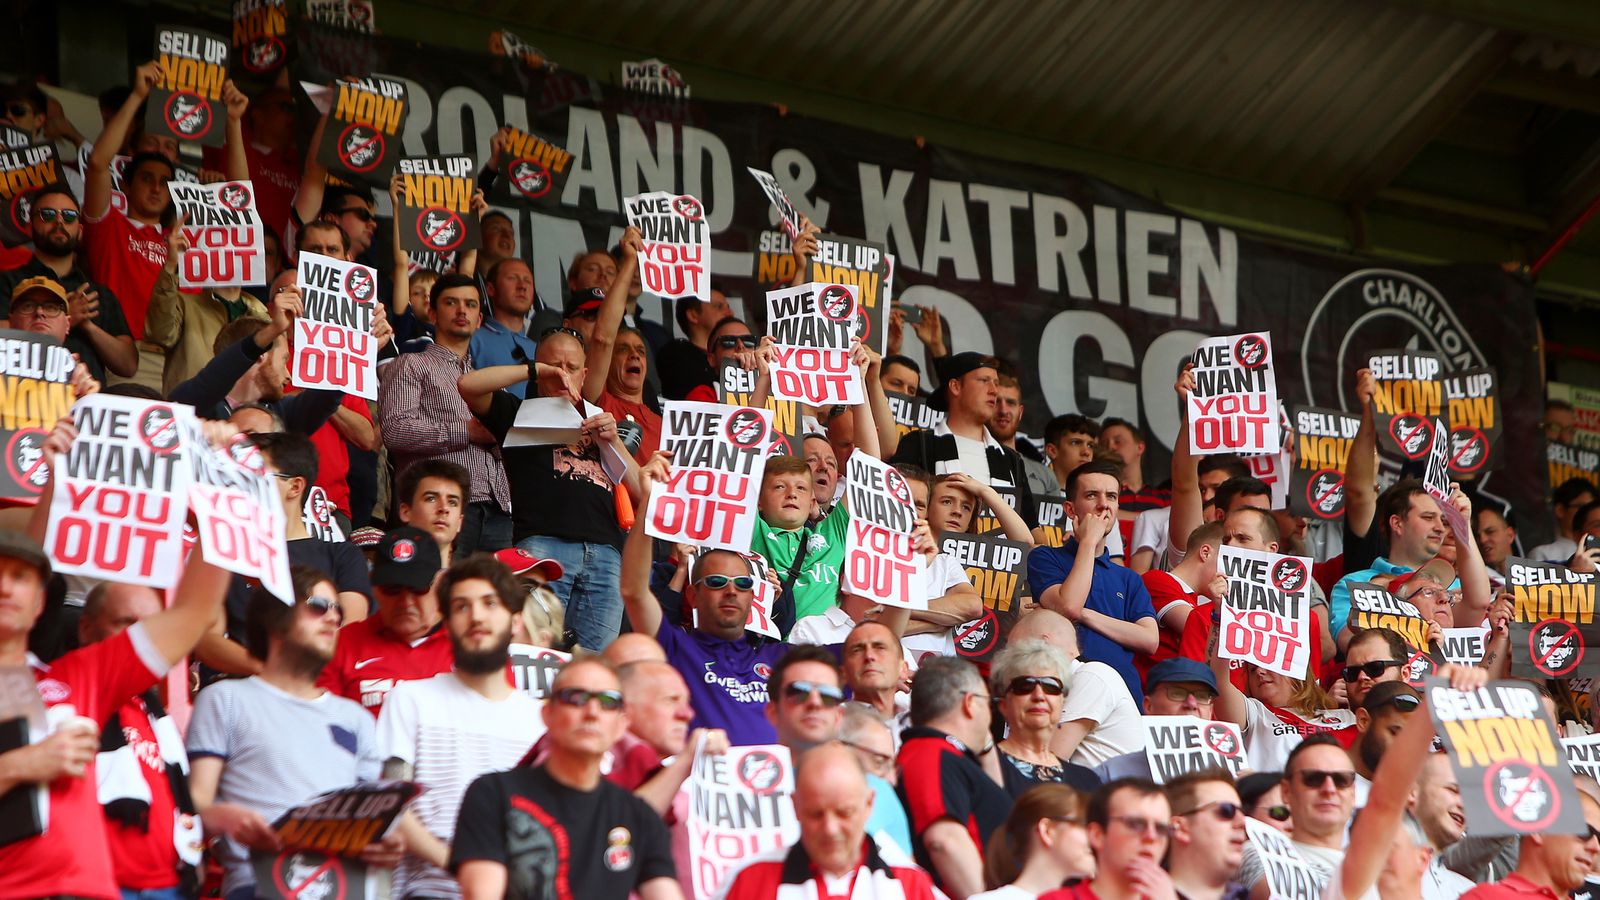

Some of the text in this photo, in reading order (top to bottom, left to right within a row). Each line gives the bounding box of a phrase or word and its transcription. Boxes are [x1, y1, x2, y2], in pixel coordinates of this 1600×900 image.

[159, 31, 227, 65] SELL UP
[157, 54, 226, 101] NOW
[627, 64, 661, 79] WE
[381, 80, 404, 100] UP
[335, 84, 404, 135] NOW
[0, 145, 53, 172] ELL UP
[506, 126, 571, 173] NOW
[399, 157, 473, 177] SELL UP
[175, 186, 217, 206] WE
[404, 175, 473, 214] NOW
[630, 198, 672, 216] WE
[178, 203, 254, 226] WANT
[634, 216, 704, 243] WANT
[183, 227, 255, 248] YOU
[641, 243, 702, 263] YOU
[759, 231, 791, 253] SEL
[858, 162, 1239, 327] KATRIEN
[184, 249, 257, 282] OUT
[759, 250, 798, 283] NO
[812, 240, 880, 271] SELL UP
[304, 262, 342, 292] WE
[643, 261, 703, 295] OUT
[301, 287, 375, 333] WANT
[771, 291, 816, 319] WE
[301, 321, 368, 357] YOU
[771, 316, 851, 349] WANT
[1362, 278, 1472, 370] CHARLTON
[45, 345, 76, 383] UP
[298, 348, 369, 393] OUT
[776, 346, 849, 374] YOU
[1190, 345, 1232, 368] WE
[1369, 355, 1439, 381] SELL UP
[775, 370, 852, 402] OUT
[1191, 364, 1269, 398] WANT
[1444, 373, 1492, 399] LL UP
[0, 375, 79, 432] NOW
[888, 396, 915, 426] ELL
[1191, 395, 1267, 415] YOU
[1374, 380, 1442, 416] NOW
[1448, 396, 1494, 430] OW
[72, 405, 131, 440] WE
[667, 409, 723, 436] WE
[1194, 417, 1270, 450] OUT
[1298, 411, 1340, 438] SELL
[66, 441, 182, 493] WANT
[667, 438, 761, 475] WANT
[1546, 442, 1600, 471] SELL UP
[664, 470, 749, 502] YOU
[851, 460, 883, 492] WE
[66, 482, 171, 525] YOU
[651, 495, 746, 544] OUT
[851, 484, 917, 533] WANT
[1037, 501, 1064, 526] UP
[53, 516, 169, 578] OUT
[853, 520, 916, 562] YOU
[942, 538, 1023, 572] SELL UP
[850, 549, 917, 603] OUT
[1222, 555, 1269, 585] WE
[1510, 564, 1595, 587] SELL UP
[966, 566, 1019, 613] OW
[1224, 581, 1305, 620] WANT
[1354, 589, 1421, 619] SELL UP
[1512, 584, 1596, 625] NOW
[1225, 605, 1299, 640] YOU
[1357, 611, 1431, 655] NOW
[1224, 621, 1302, 673] OUT
[1442, 636, 1483, 659] WE
[1432, 686, 1505, 722] SELL
[1495, 686, 1541, 721] UP
[1149, 725, 1203, 750] WE
[1444, 716, 1559, 769] NOW
[1150, 751, 1244, 784] WANT
[354, 792, 401, 818] UP
[694, 783, 785, 829] WANT
[1252, 830, 1297, 860] WE
[1266, 858, 1321, 900] WA
